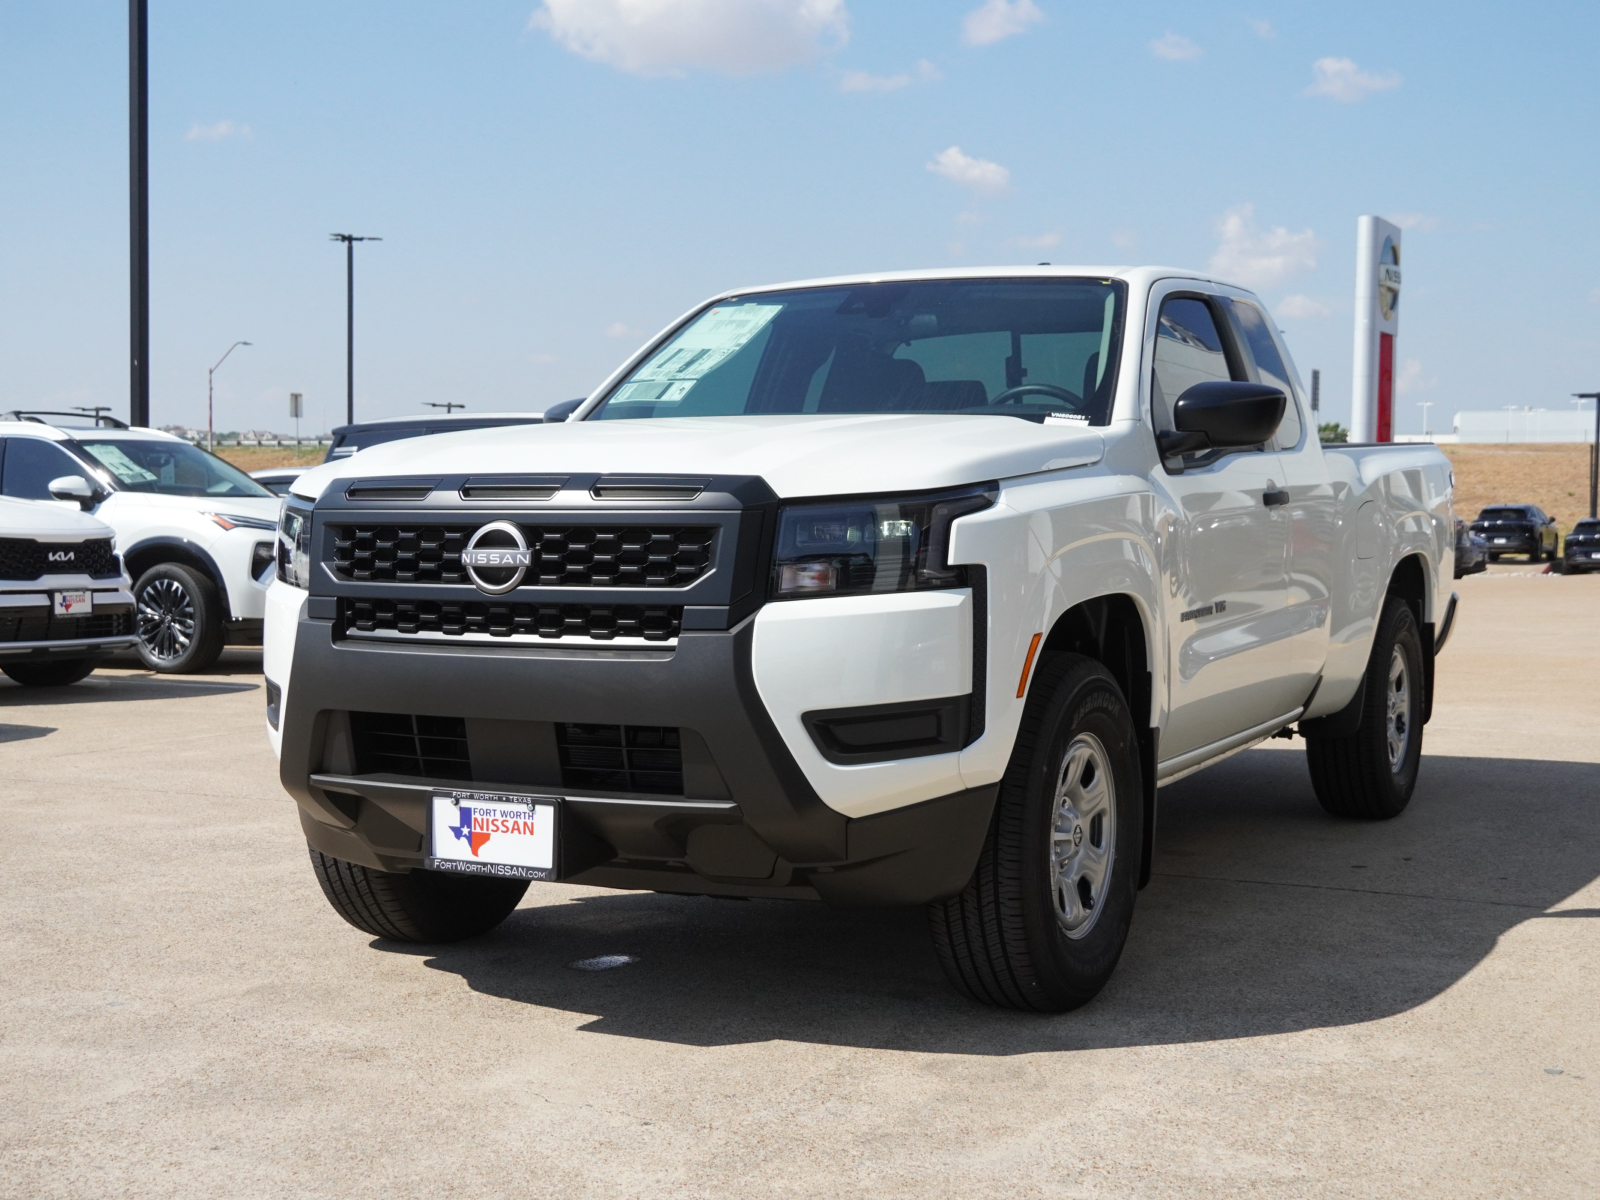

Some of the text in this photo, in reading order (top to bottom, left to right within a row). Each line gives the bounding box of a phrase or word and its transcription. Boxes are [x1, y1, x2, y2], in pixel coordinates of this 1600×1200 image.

[462, 553, 530, 564] NISSAN
[452, 791, 532, 804] FORT WORTH TEXAS
[473, 807, 534, 821] FORT WORTH
[473, 817, 534, 836] NISSAN
